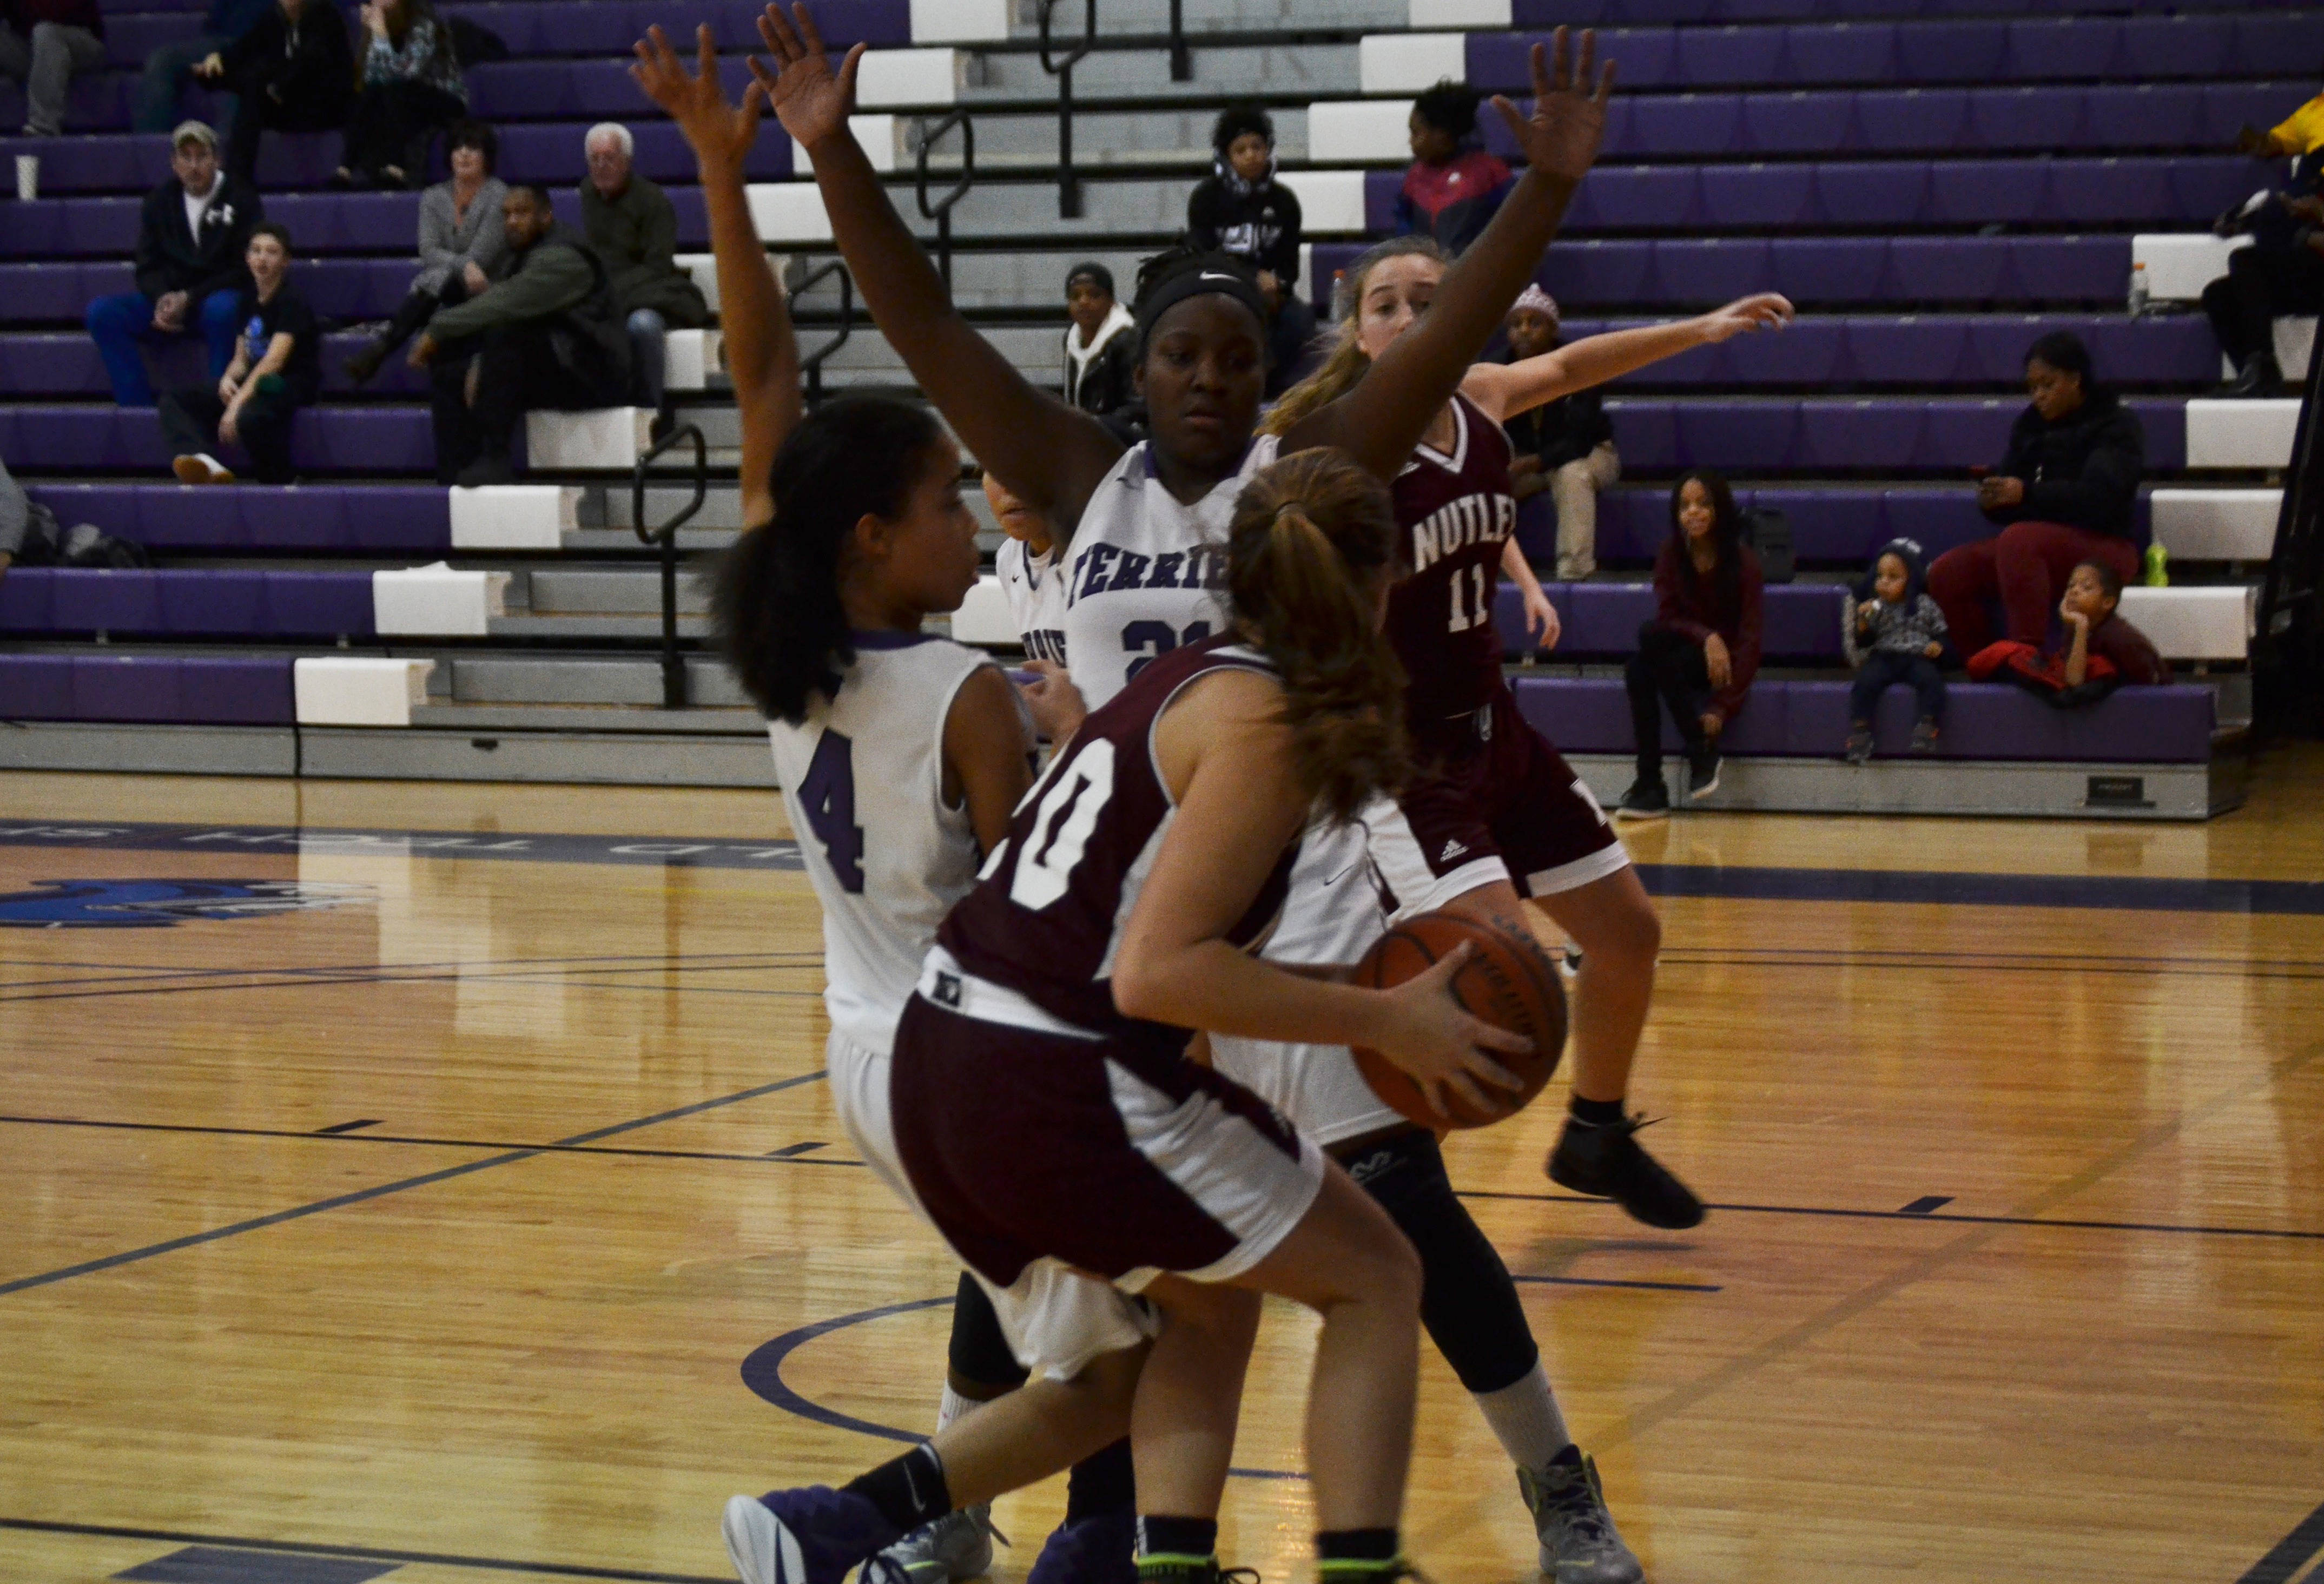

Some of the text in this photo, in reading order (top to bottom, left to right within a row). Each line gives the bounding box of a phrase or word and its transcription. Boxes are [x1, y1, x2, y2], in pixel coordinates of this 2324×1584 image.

[1448, 562, 1489, 633] 11
[797, 728, 863, 893] 4
[975, 727, 1115, 911] 0
